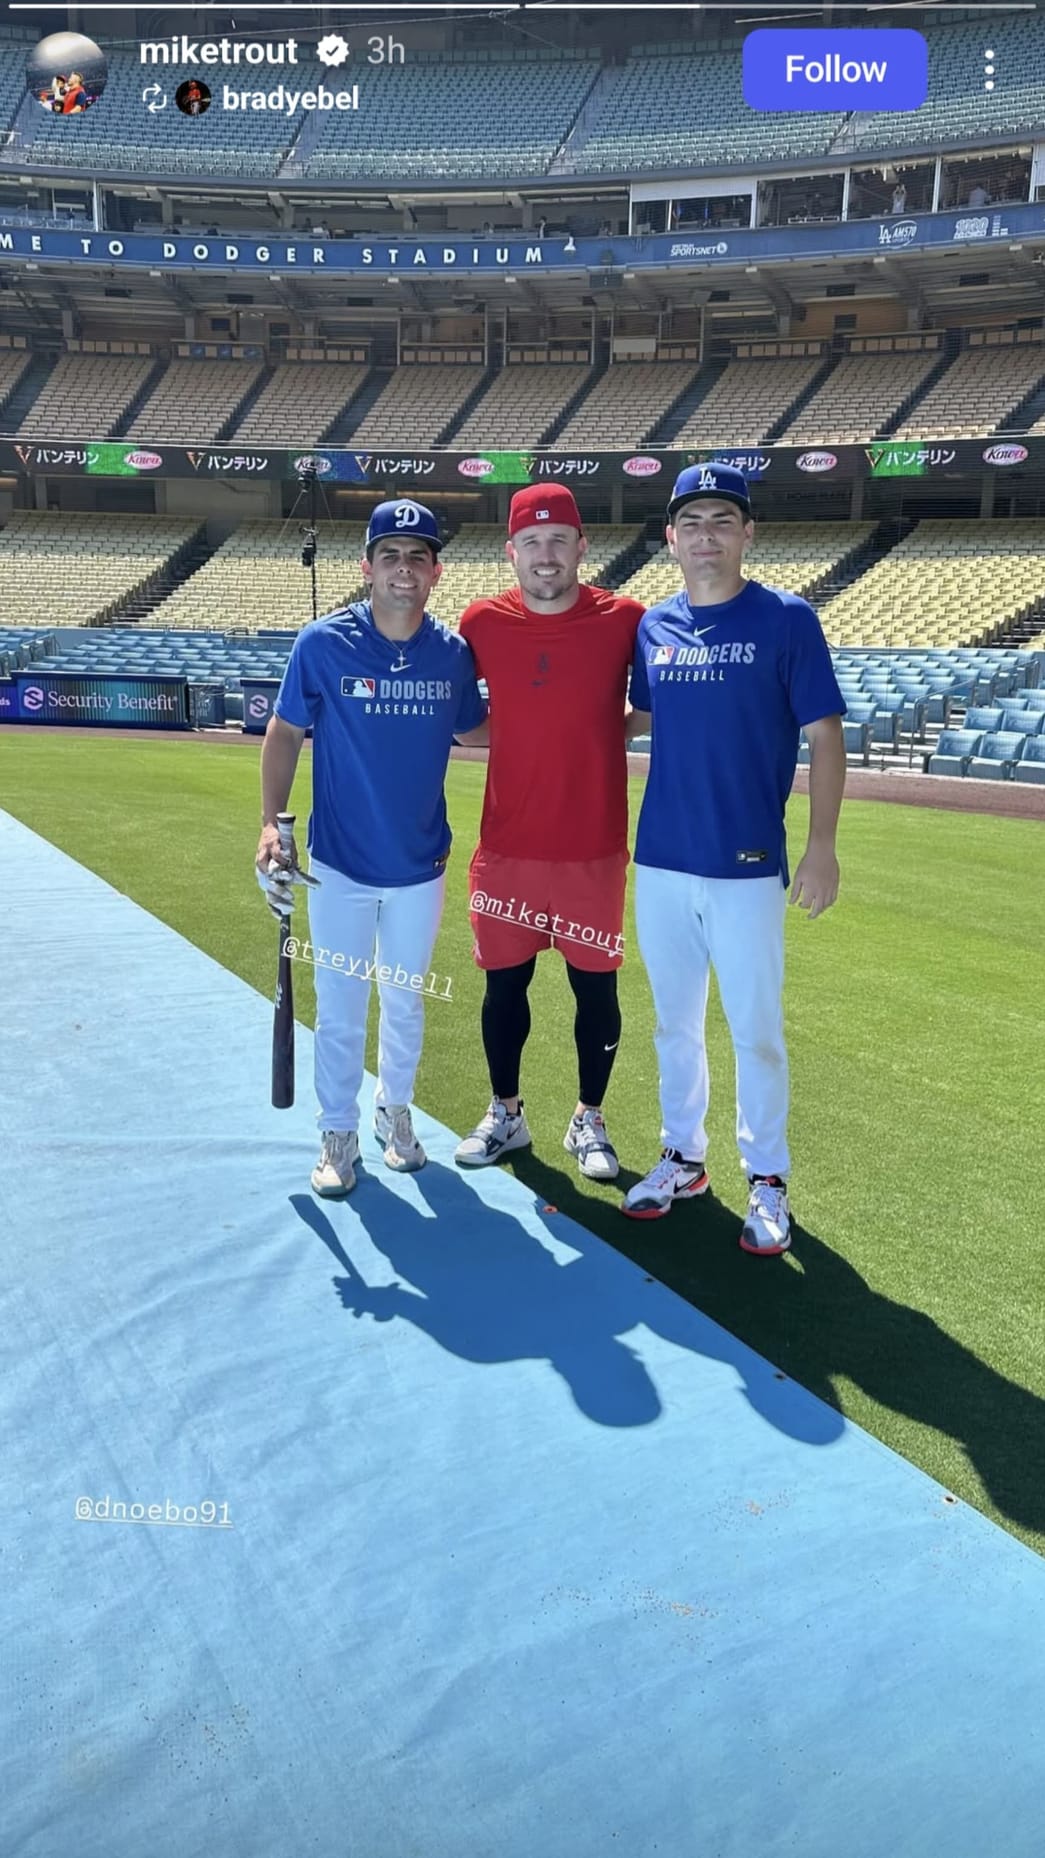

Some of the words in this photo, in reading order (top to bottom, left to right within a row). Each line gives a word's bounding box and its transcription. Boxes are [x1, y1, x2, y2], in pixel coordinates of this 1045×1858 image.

[81, 238, 124, 256] TO
[163, 243, 325, 263] DODGER
[362, 247, 543, 265] STADIUM
[799, 453, 836, 467] Kowa
[985, 446, 1027, 461] Kowa
[698, 466, 717, 490] LA
[394, 504, 421, 528] D
[675, 642, 756, 666] DODGERS
[659, 669, 726, 682] BASEBALL
[48, 690, 112, 712] Security
[380, 679, 452, 701] DODGERS
[365, 703, 435, 716] BASEBALL
